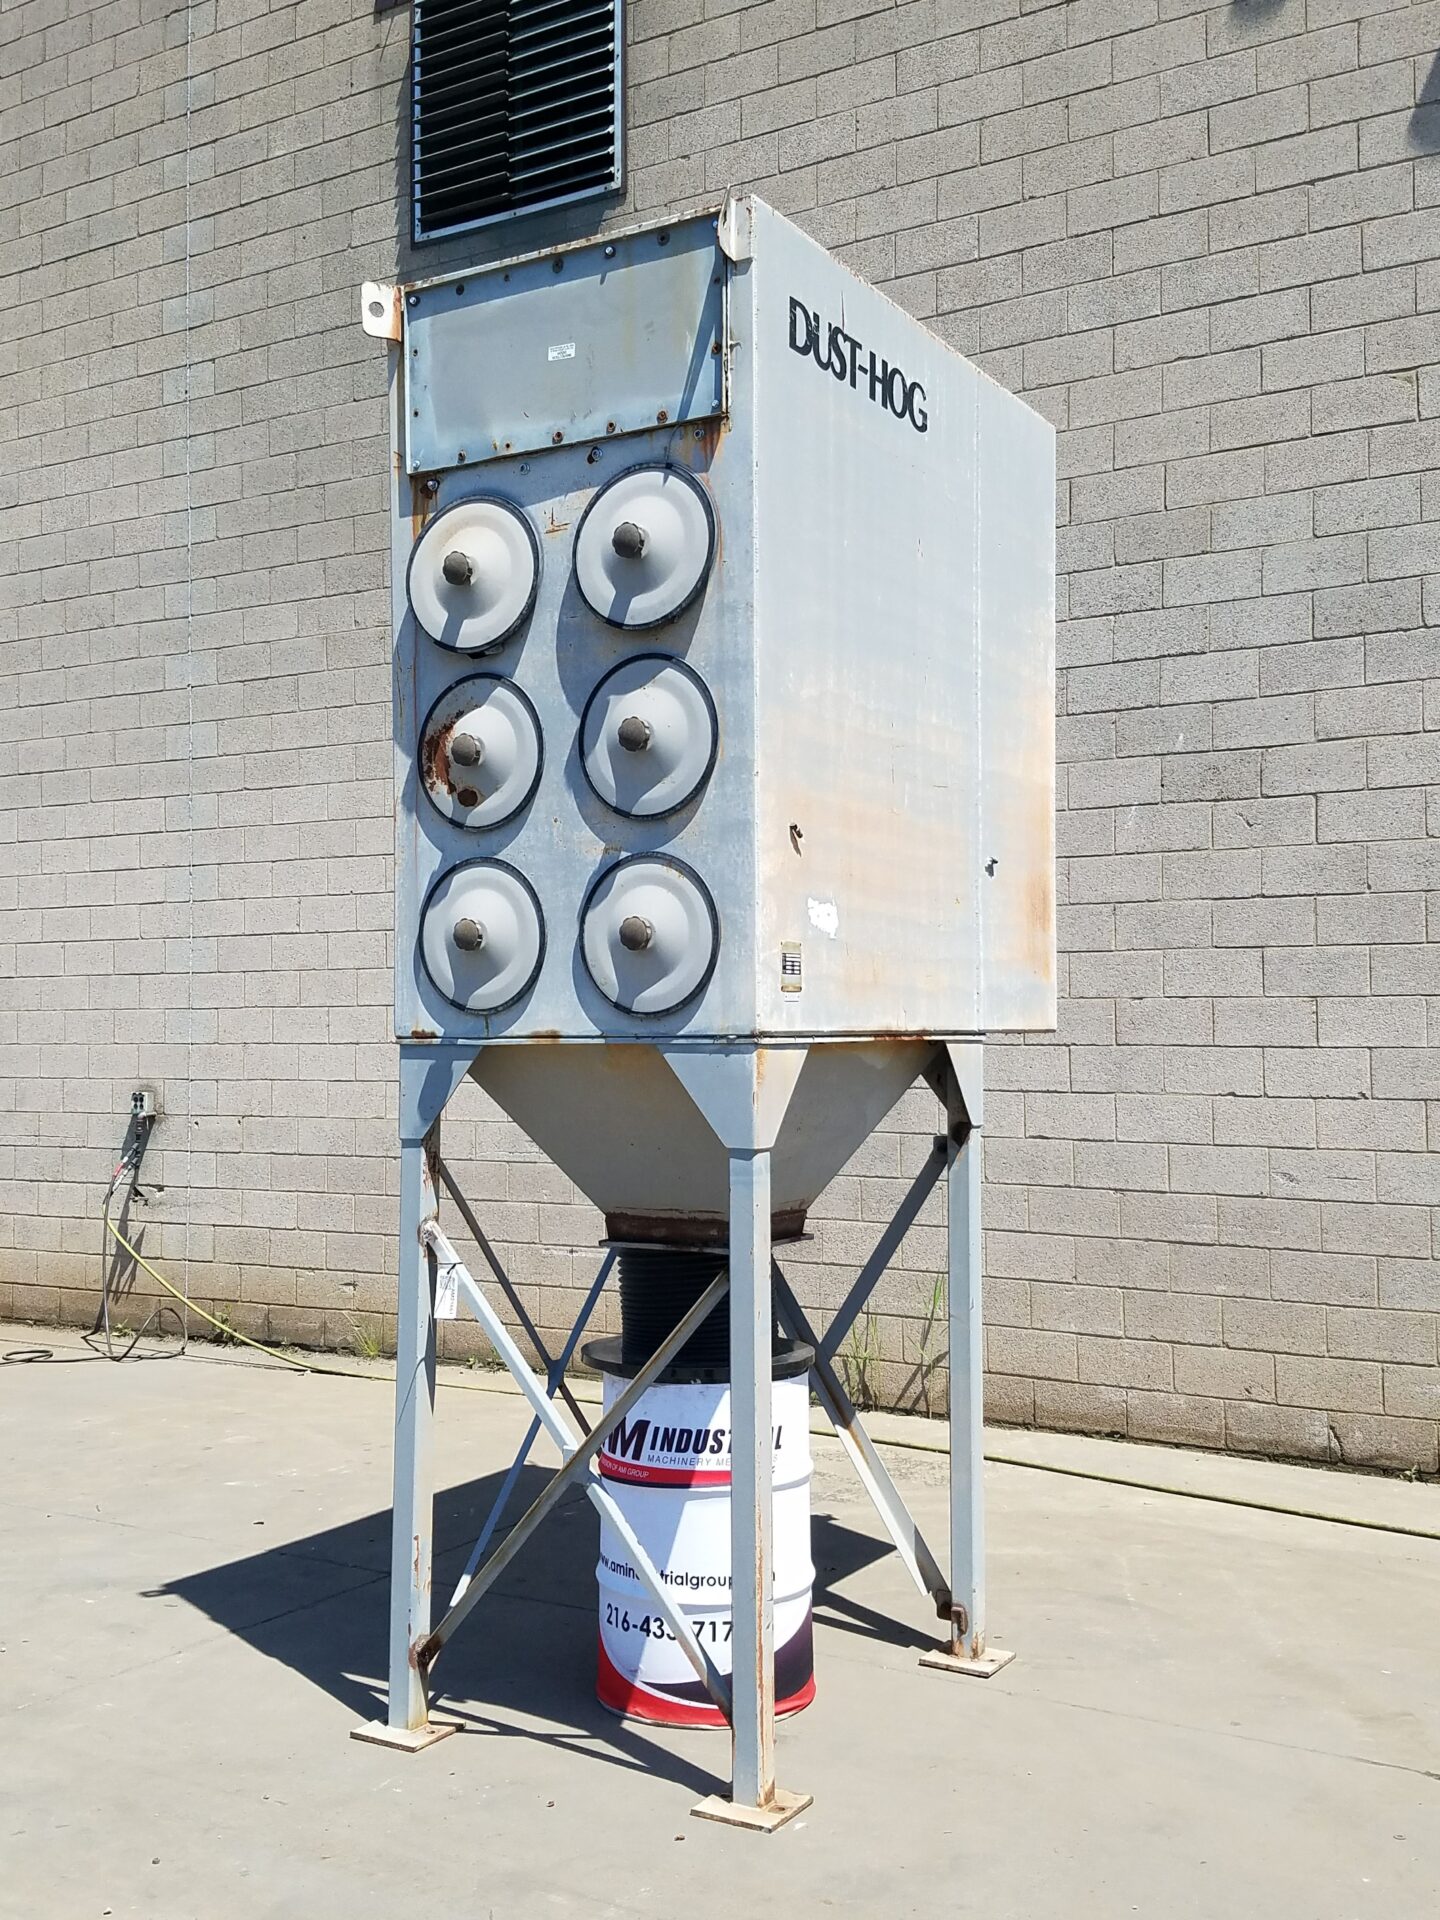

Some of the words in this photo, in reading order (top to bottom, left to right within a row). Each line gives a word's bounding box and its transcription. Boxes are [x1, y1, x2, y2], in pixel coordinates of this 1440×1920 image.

[788, 295, 928, 433] DUST-HOG
[603, 1416, 651, 1462] M
[627, 1468, 650, 1478] GROUP
[647, 1454, 712, 1467] MACHINERY
